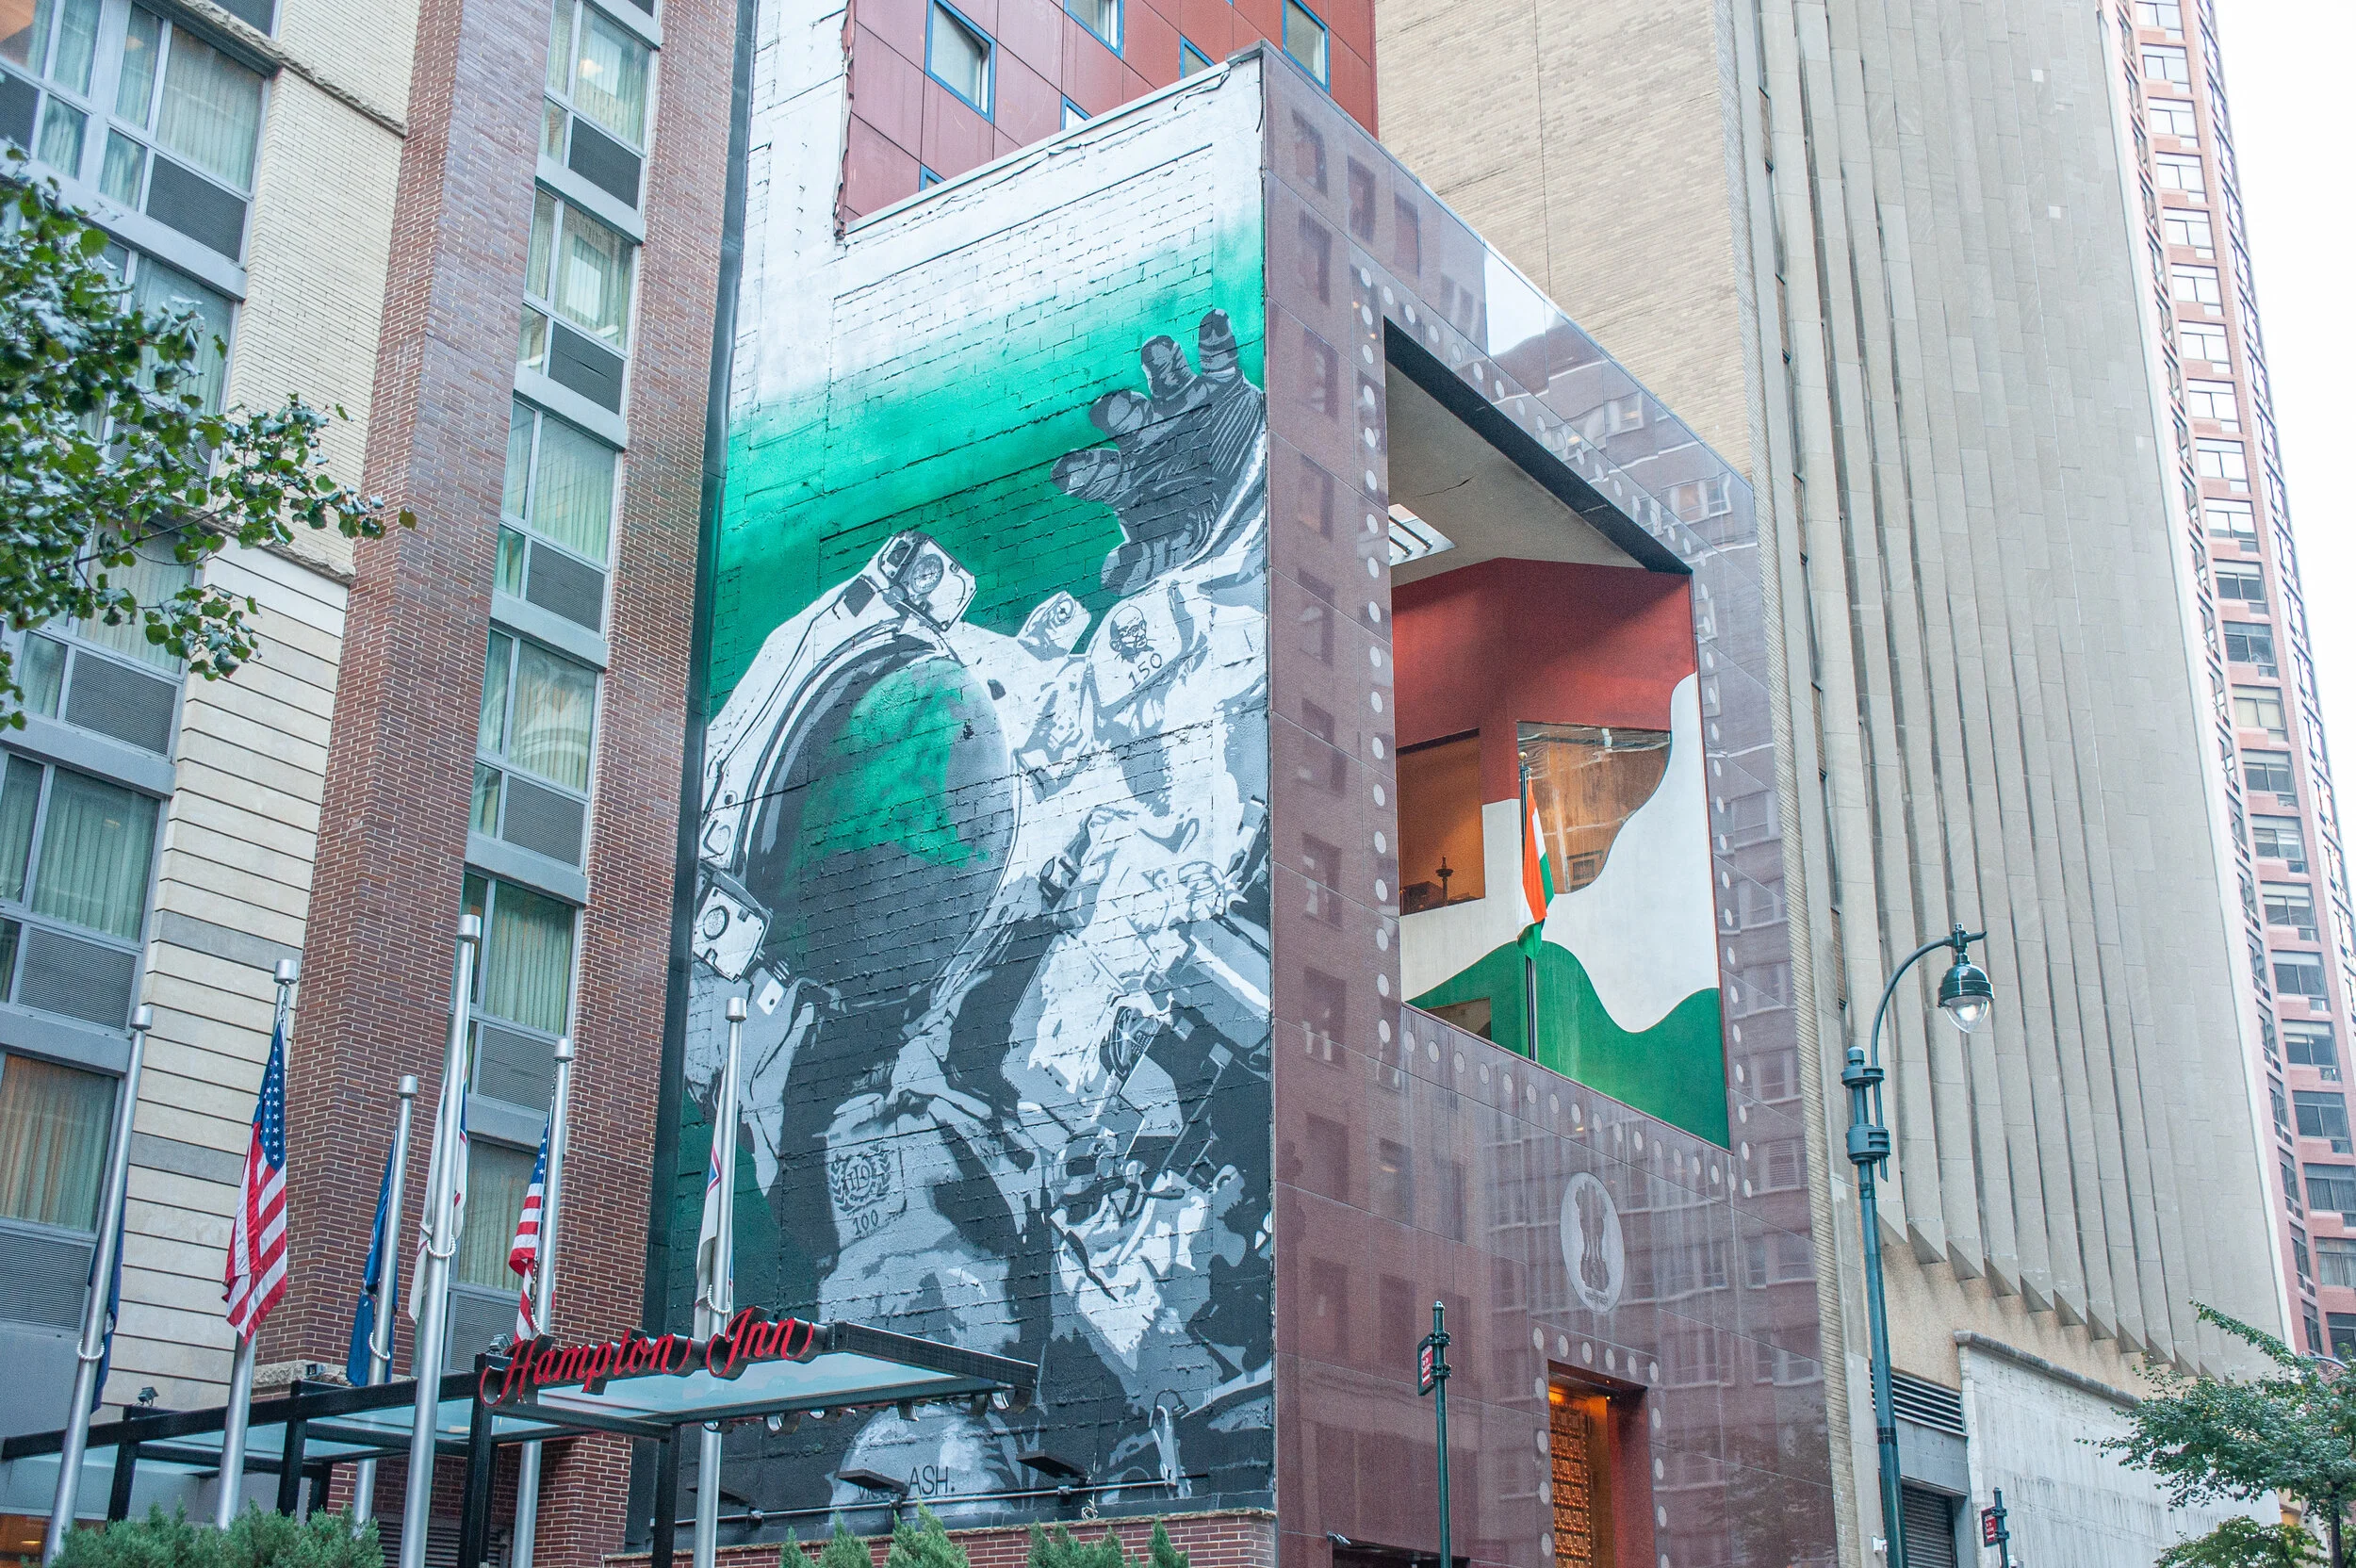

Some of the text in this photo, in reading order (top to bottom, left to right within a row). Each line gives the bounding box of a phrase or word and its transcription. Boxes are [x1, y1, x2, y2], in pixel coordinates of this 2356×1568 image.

[1128, 653, 1162, 690] 150
[852, 1209, 878, 1234] 100
[480, 1307, 814, 1407] Hampton Inn
[908, 1465, 956, 1495] ASH.
